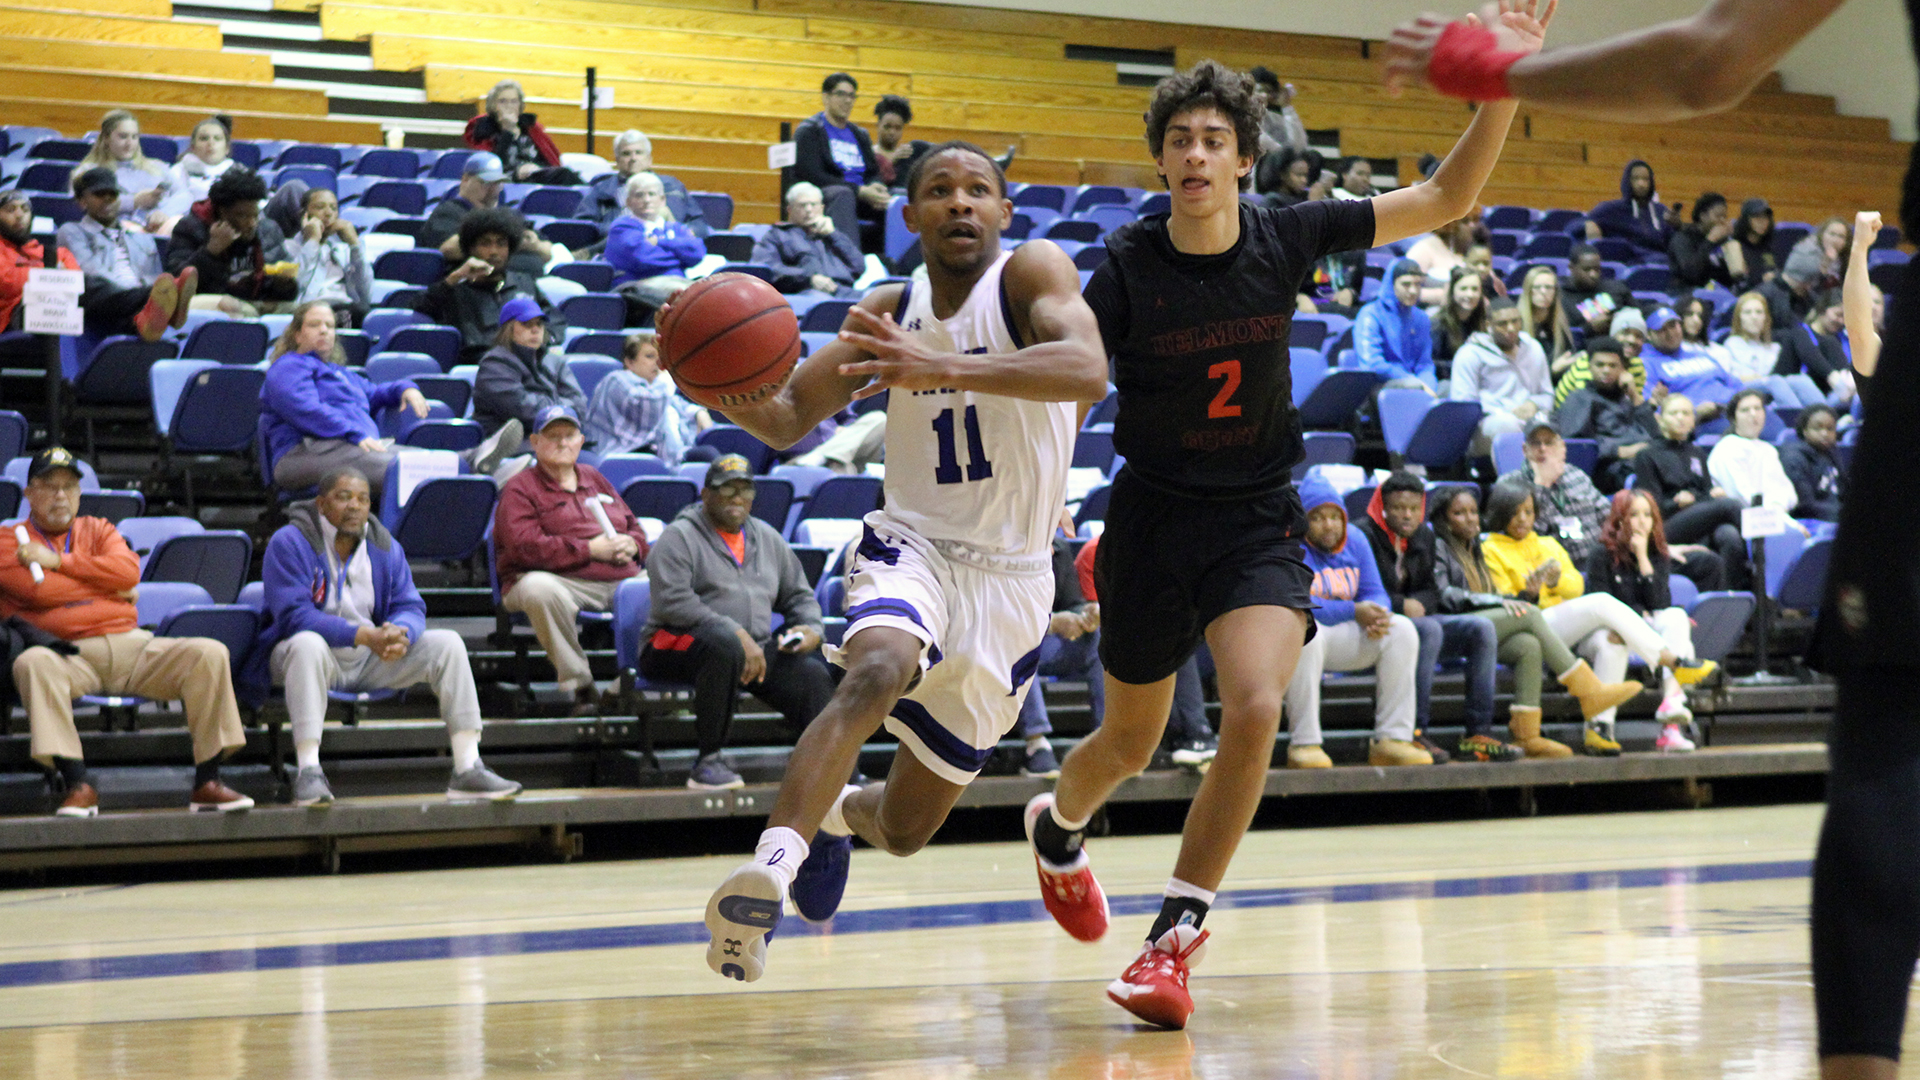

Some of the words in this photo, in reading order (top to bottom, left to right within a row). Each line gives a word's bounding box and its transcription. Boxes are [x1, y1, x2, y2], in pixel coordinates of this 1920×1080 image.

[39, 275, 76, 284] RESERVED
[1150, 314, 1286, 357] BELMONT
[1207, 359, 1242, 419] 2
[931, 404, 993, 484] 11
